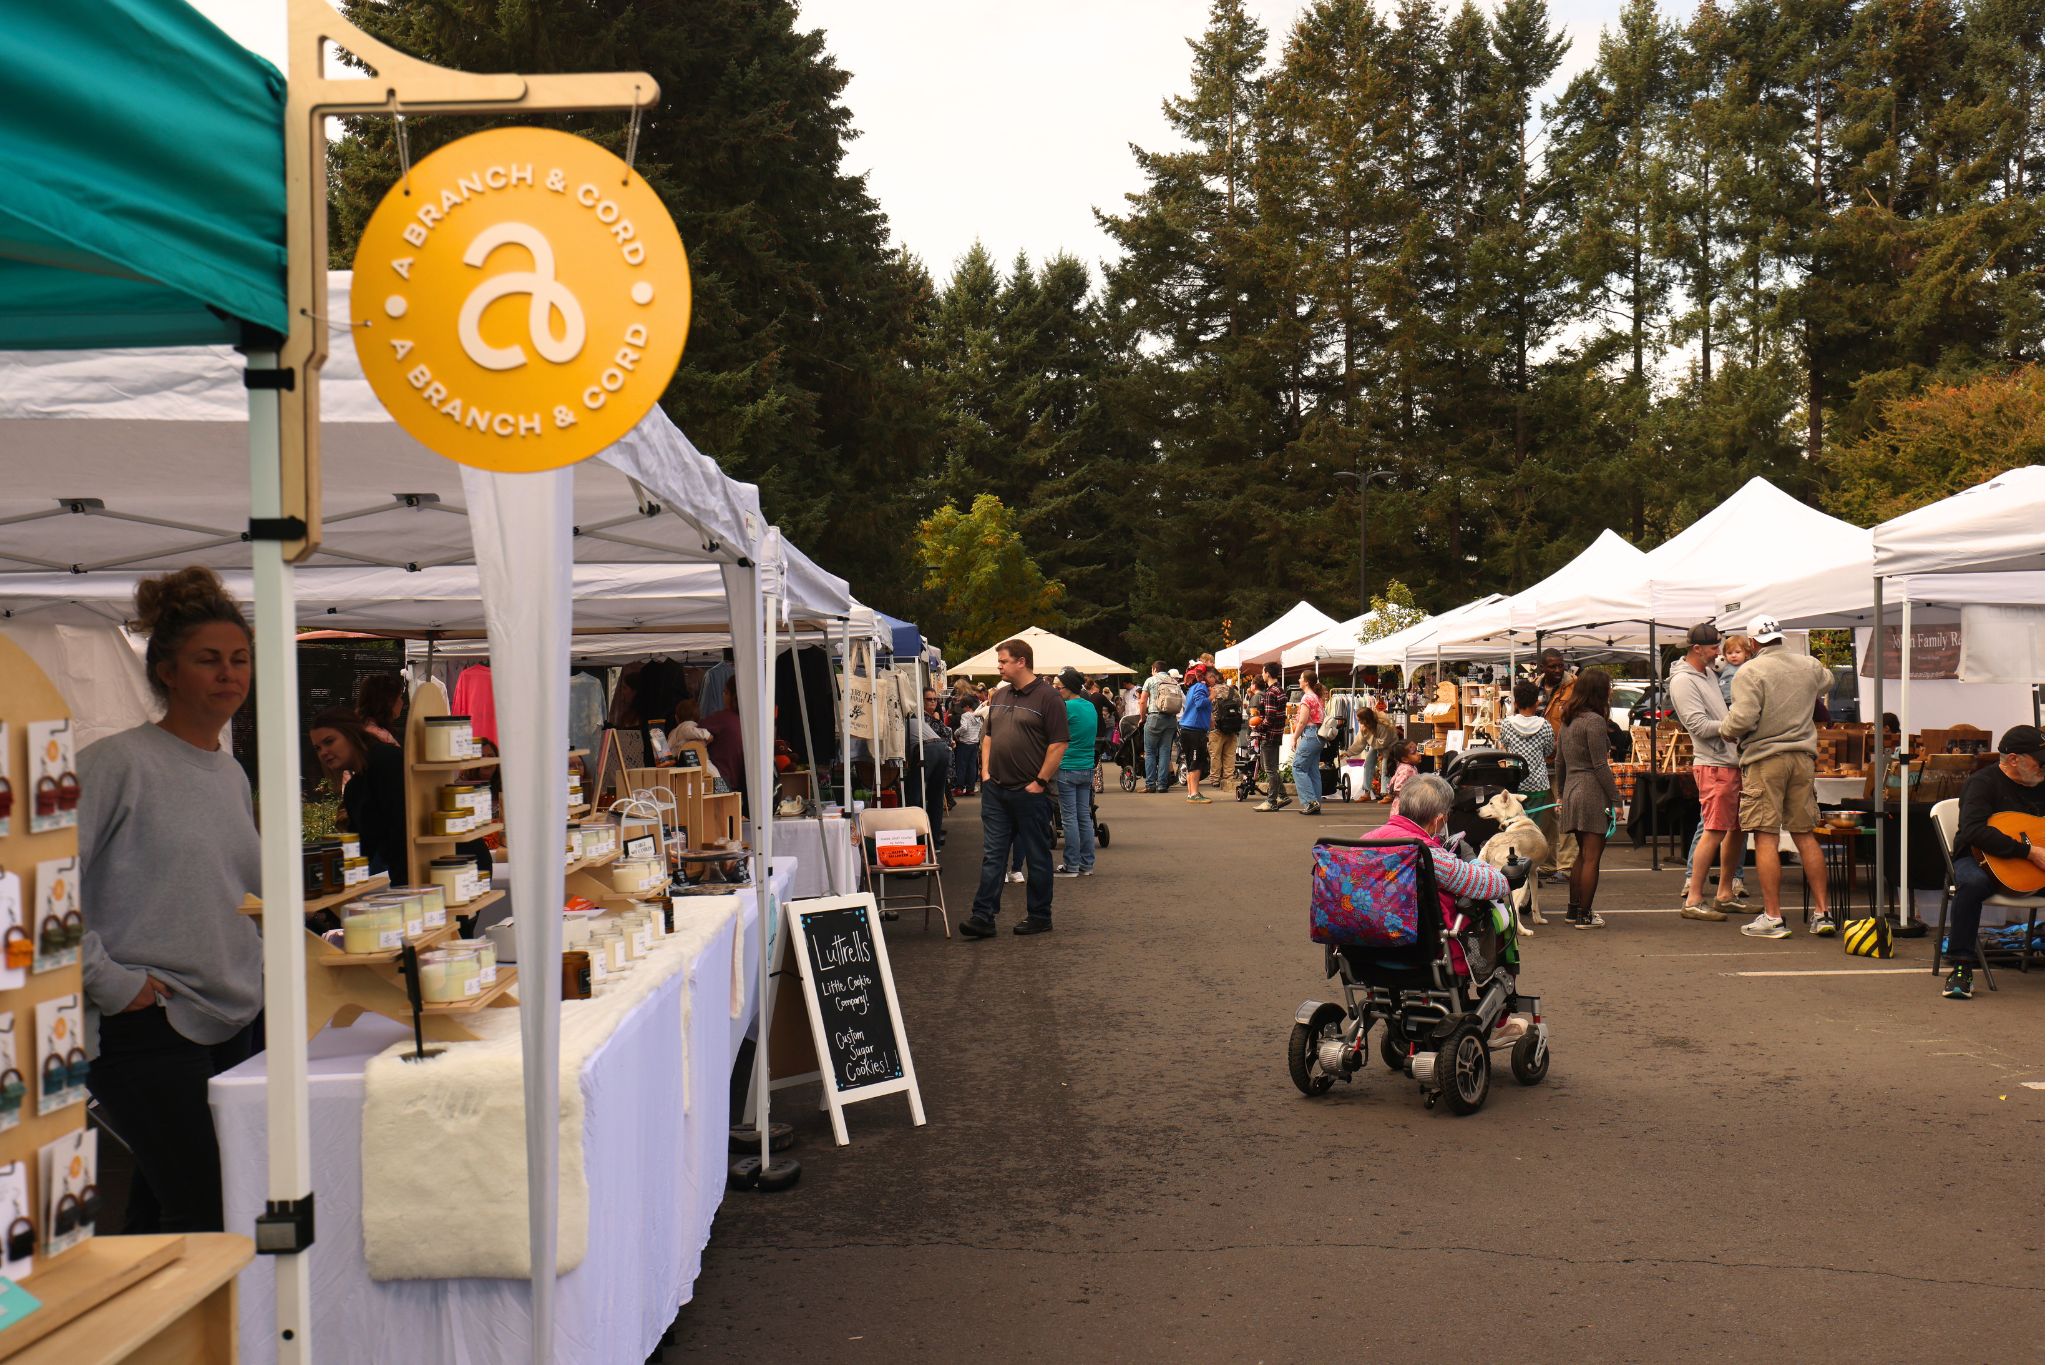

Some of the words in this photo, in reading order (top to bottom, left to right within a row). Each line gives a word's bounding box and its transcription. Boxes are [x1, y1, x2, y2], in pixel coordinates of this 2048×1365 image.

[545, 168, 567, 194] &
[402, 163, 533, 248] BRANCH
[576, 183, 646, 267] CORD
[391, 255, 415, 280] A
[390, 338, 414, 360] A
[407, 364, 542, 437] BRANCH
[553, 405, 577, 429] &
[582, 322, 648, 411] CORD
[1917, 632, 1948, 651] Family
[812, 930, 871, 971] Luttrells
[821, 979, 846, 996] Little
[847, 974, 872, 991] Cookie
[835, 989, 870, 1015] Company!
[835, 1026, 865, 1050] Custom
[845, 1051, 890, 1081] Cookies!
[850, 1045, 874, 1064] Sugar
